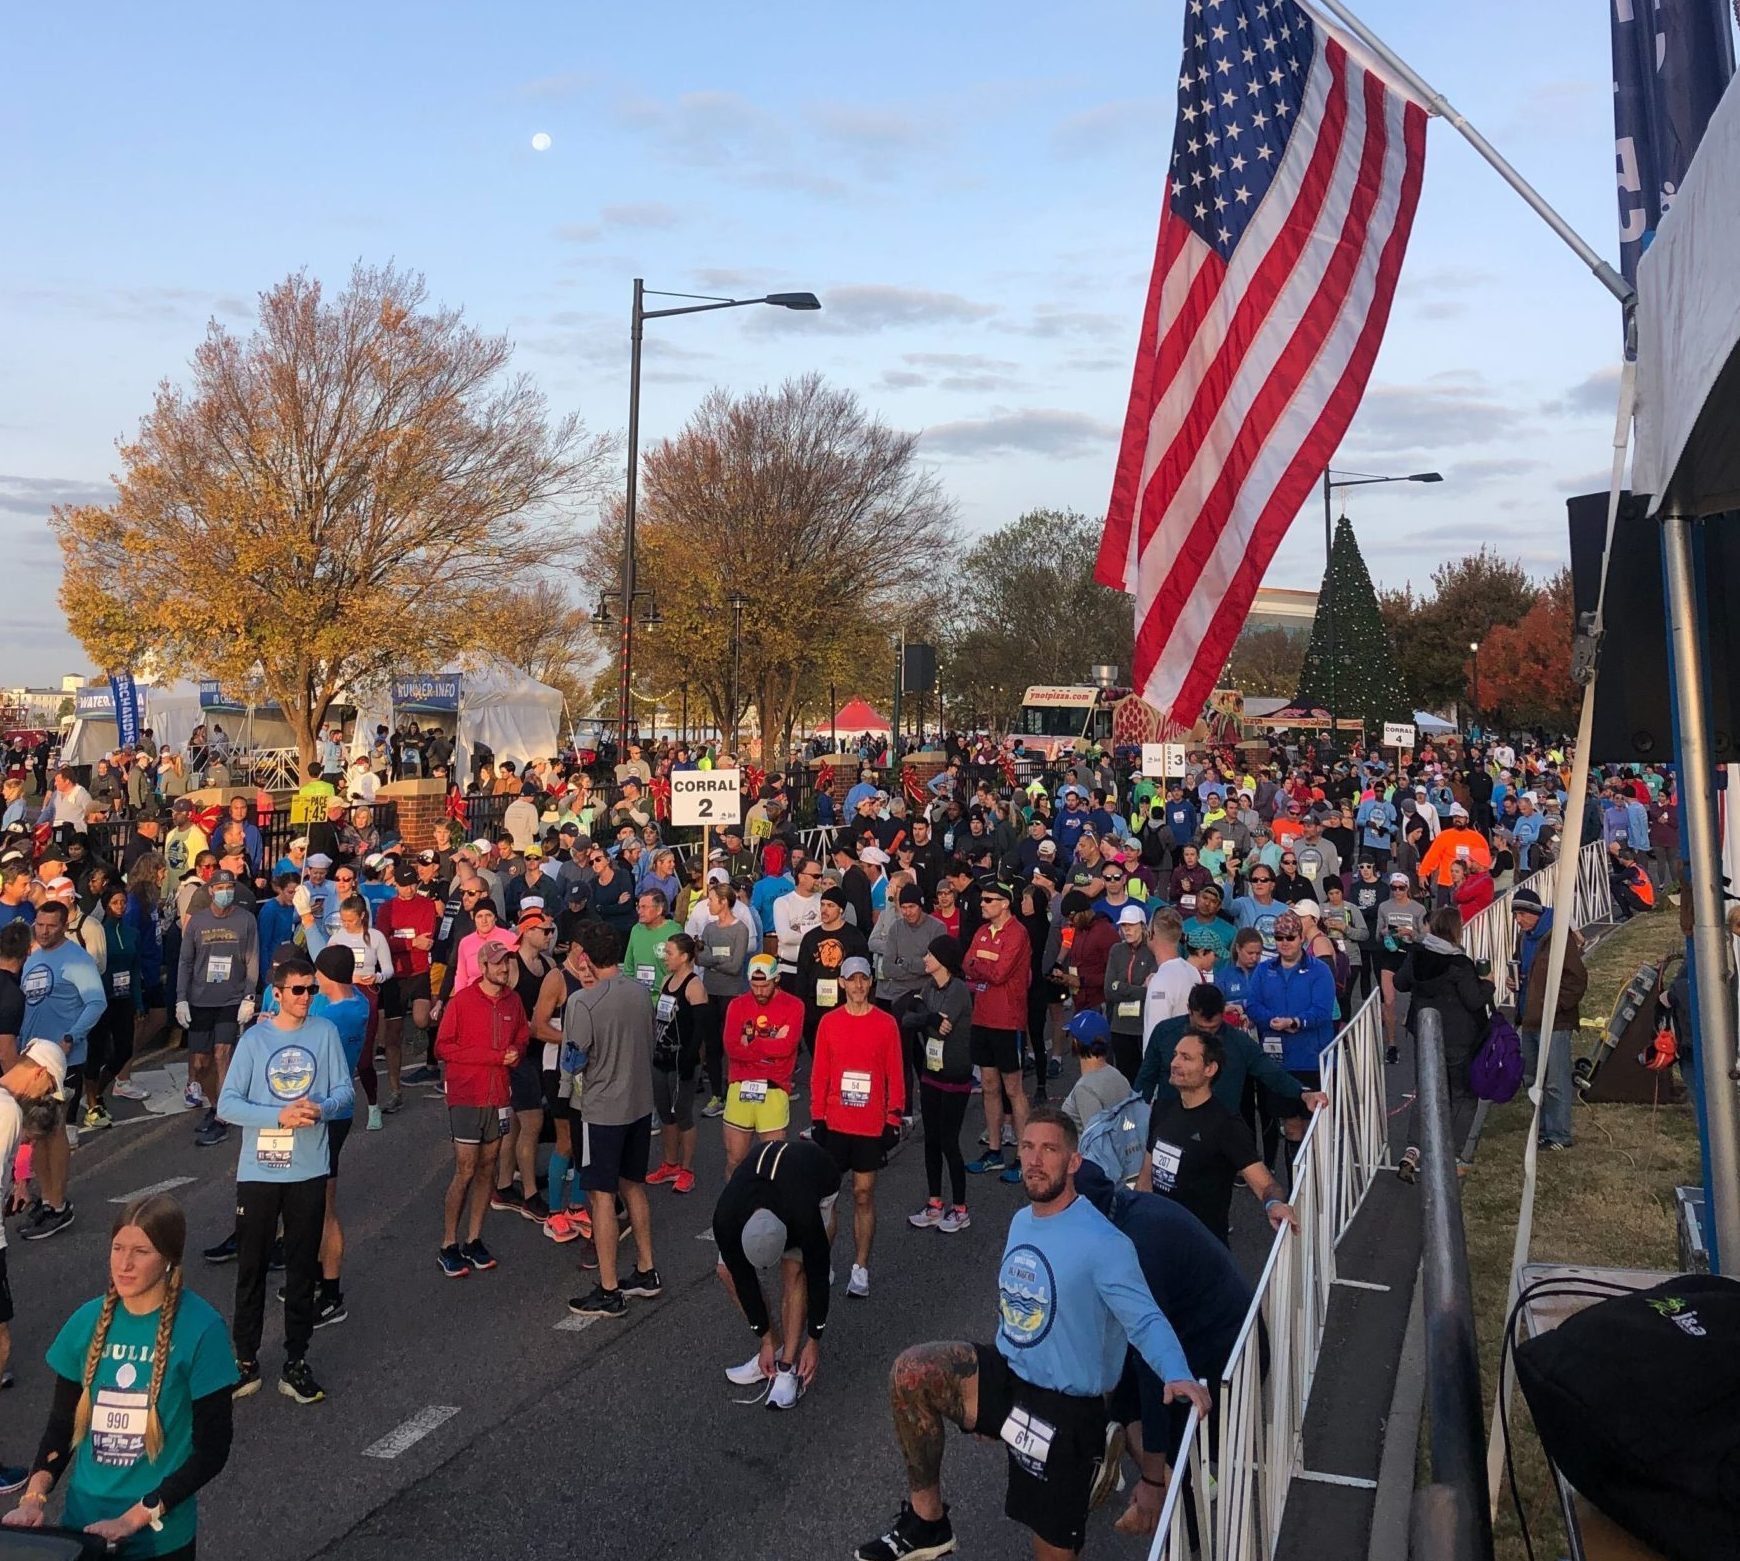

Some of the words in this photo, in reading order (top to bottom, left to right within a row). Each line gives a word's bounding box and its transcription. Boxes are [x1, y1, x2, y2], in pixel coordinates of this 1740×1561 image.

[398, 683, 434, 698] RUNNER
[435, 683, 455, 698] INFO
[1030, 691, 1090, 702] ynotpizza.com
[79, 695, 110, 709] WATER
[1396, 735, 1403, 743] 4
[1174, 754, 1184, 766] 3
[674, 780, 737, 792] CORRAL
[310, 796, 328, 807] PACE
[698, 798, 713, 817] 2
[303, 806, 327, 822] 1:45
[272, 1139, 278, 1149] 5
[1158, 1154, 1171, 1169] 207
[106, 1411, 130, 1430] 990
